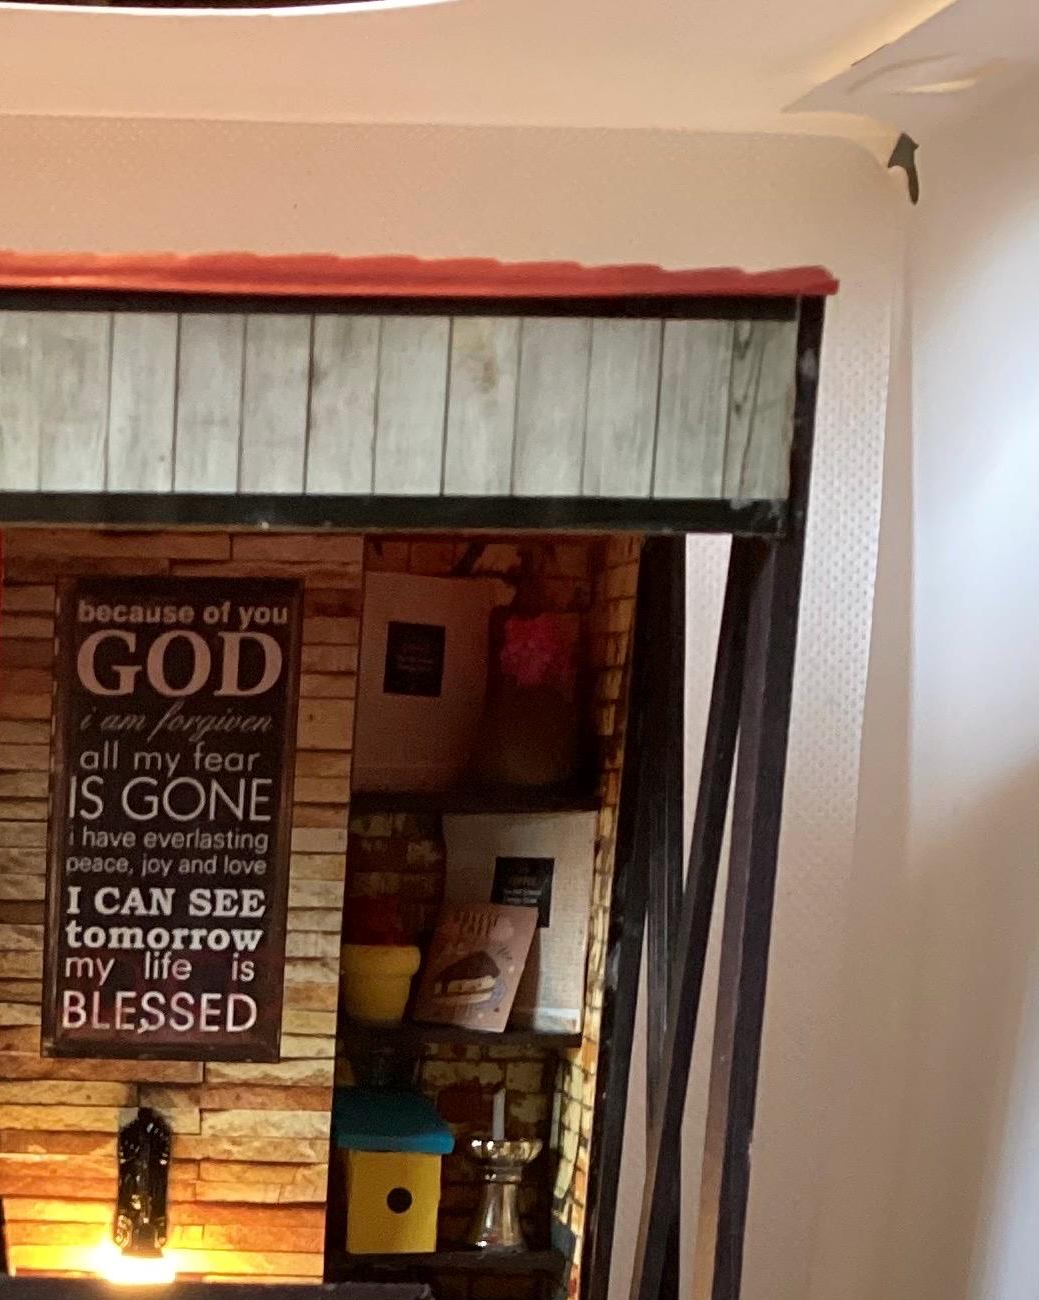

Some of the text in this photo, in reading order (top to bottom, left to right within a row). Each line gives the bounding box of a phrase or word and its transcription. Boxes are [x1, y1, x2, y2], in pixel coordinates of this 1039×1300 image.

[78, 600, 288, 631] because of you
[77, 629, 283, 698] GOD
[100, 713, 147, 731] am
[148, 701, 273, 744] forgiven
[79, 740, 261, 778] all my fear
[69, 775, 273, 821] IS GONE
[82, 826, 137, 849] have
[143, 828, 269, 854] everlasting
[65, 855, 267, 877] peace, joy and love
[66, 886, 266, 918] I CAN SEE
[65, 919, 263, 951] tomorrow
[65, 951, 255, 986] my life is
[61, 990, 258, 1034] BLESSED
